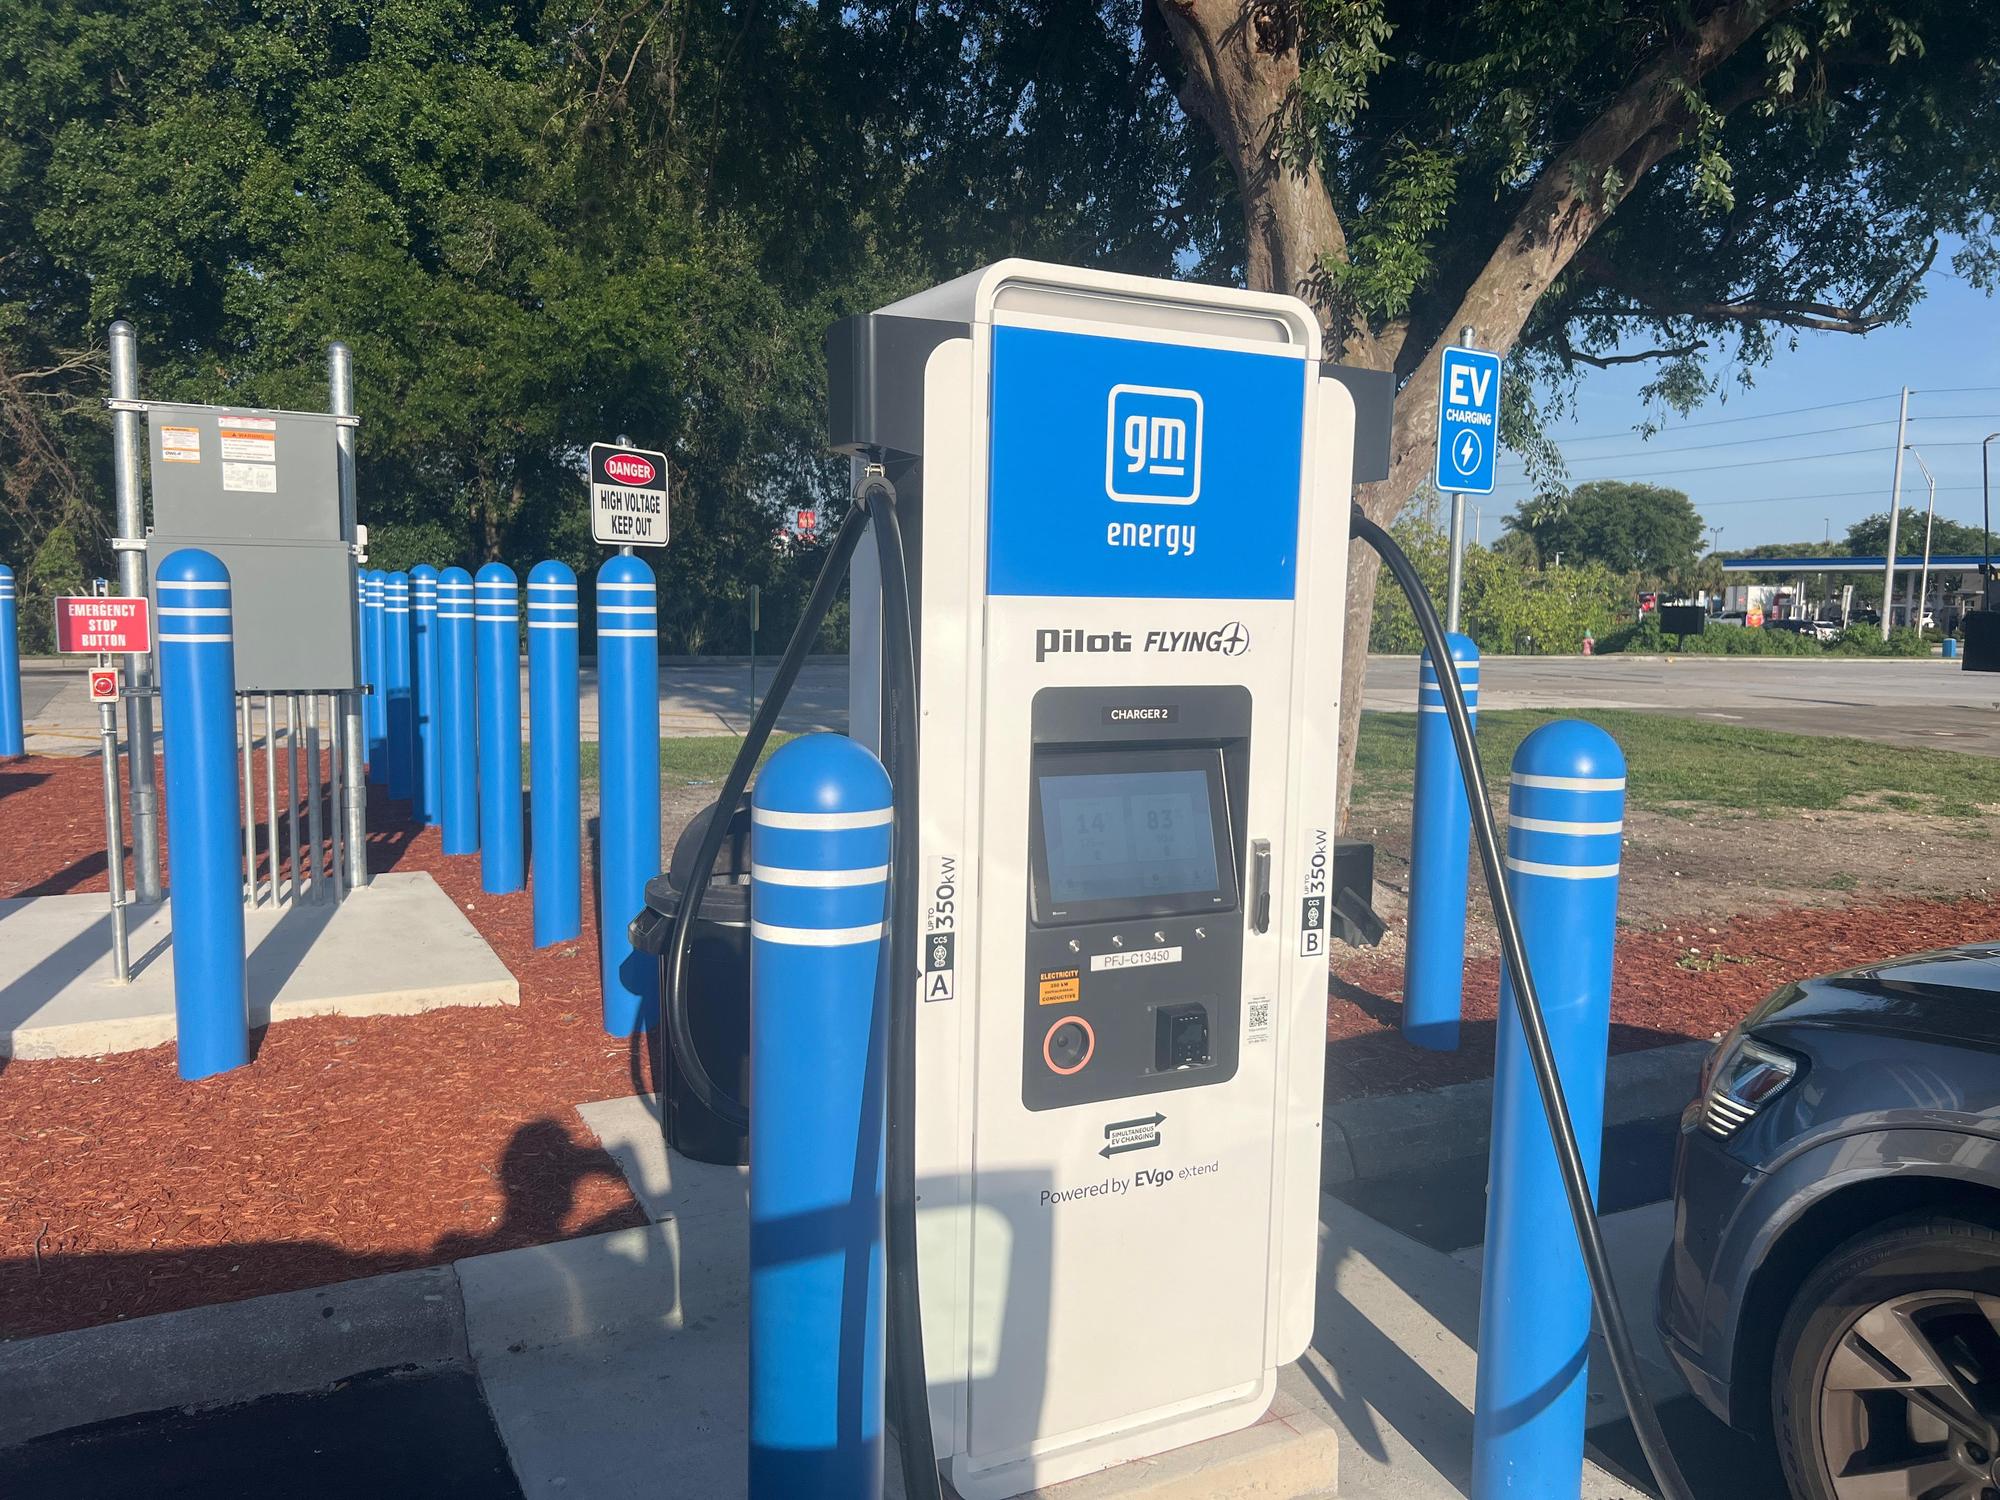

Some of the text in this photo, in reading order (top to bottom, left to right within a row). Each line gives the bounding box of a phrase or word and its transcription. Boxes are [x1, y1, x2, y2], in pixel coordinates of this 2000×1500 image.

[1449, 363, 1492, 407] EV
[1446, 408, 1492, 426] CHARGING
[1124, 415, 1186, 476] gm
[609, 460, 651, 479] DANGER
[600, 489, 661, 514] HIGH VOLTAGE
[611, 514, 652, 536] KEEP OUT
[1107, 521, 1197, 557] energy
[68, 604, 136, 617] EMERGENCY
[88, 619, 118, 632] STOP
[81, 633, 127, 647] BUTTON
[1143, 630, 1222, 653] FLYING
[1110, 708, 1168, 720] CHARGER 2
[1146, 808, 1174, 831] 83
[1310, 829, 1327, 893] 350kW
[936, 856, 955, 929] 350kW
[927, 907, 935, 931] UP TO
[933, 935, 948, 944] CCS
[1306, 933, 1319, 952] B
[1104, 950, 1170, 968] PFJ-C13450
[1040, 969, 1079, 981] ELECTRICITY
[930, 974, 949, 997] A
[1042, 993, 1076, 1002] CONDUCTIVE
[1111, 1125, 1154, 1138] SIMULTANEOUS
[1120, 1132, 1154, 1144] CHARGING
[1040, 1160, 1219, 1206] Powered by EVgo extend
